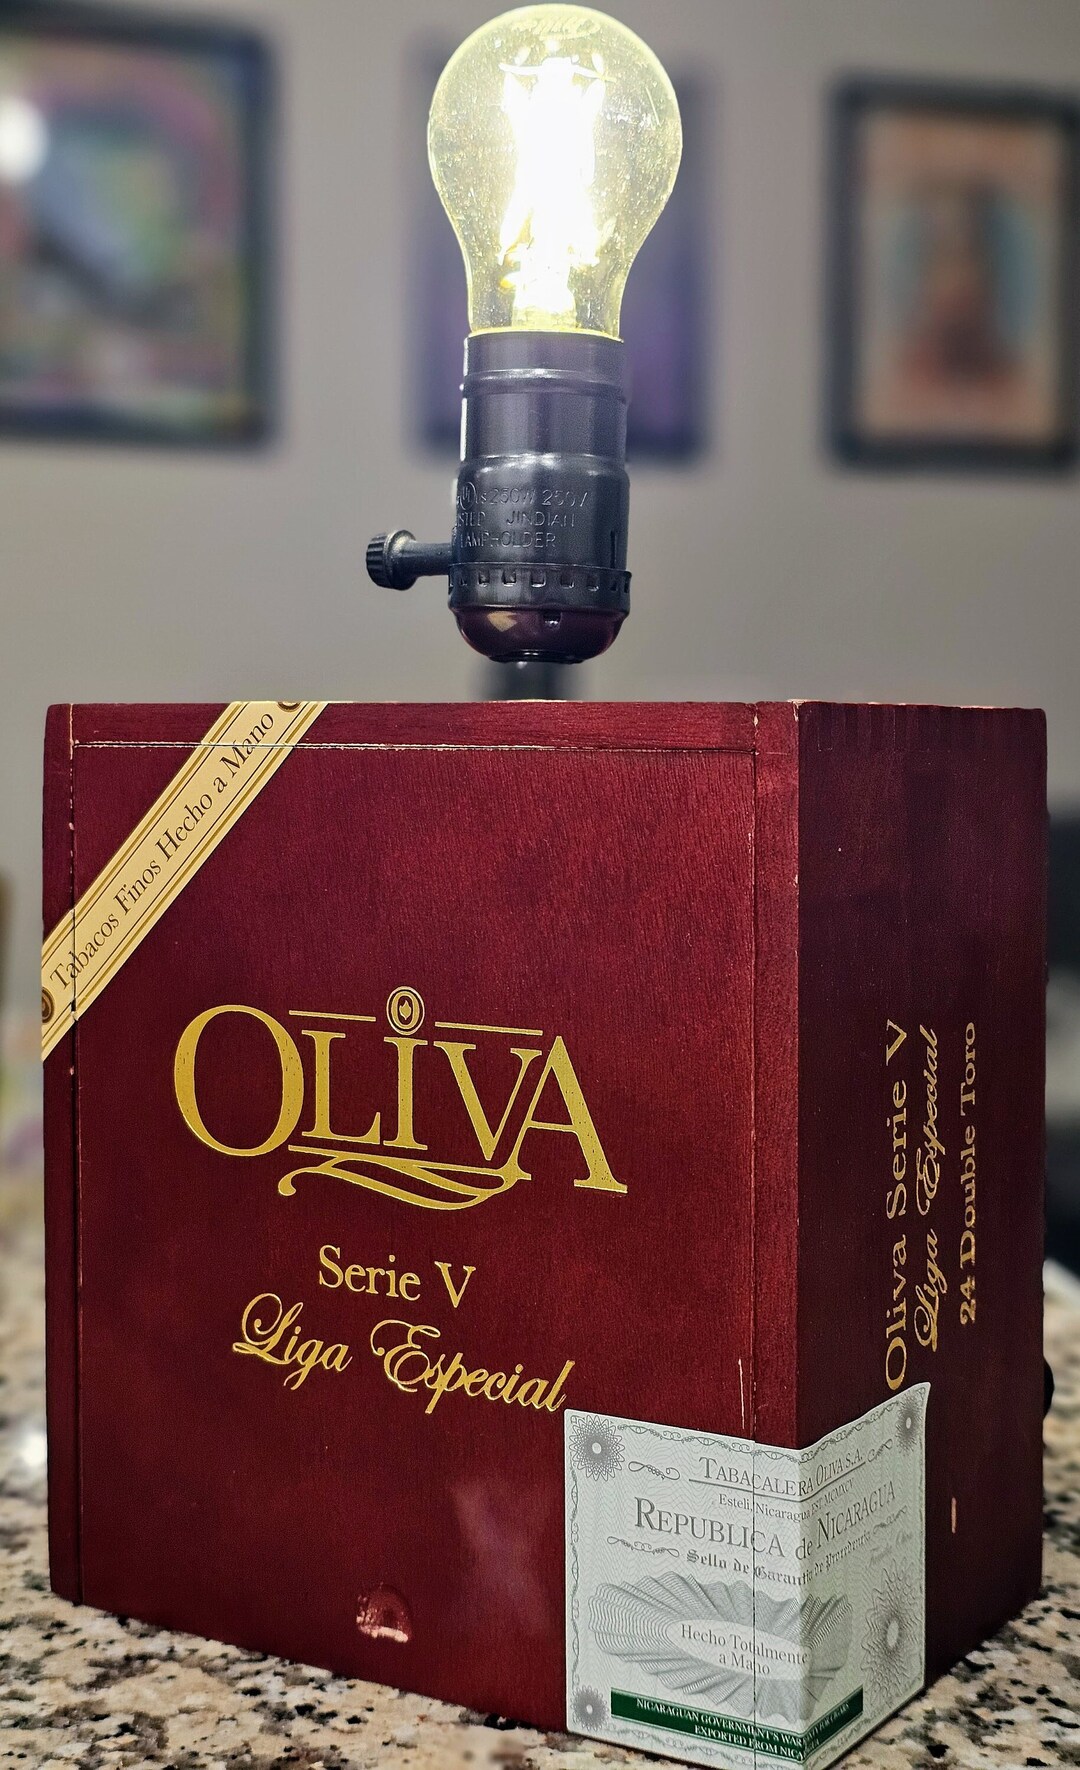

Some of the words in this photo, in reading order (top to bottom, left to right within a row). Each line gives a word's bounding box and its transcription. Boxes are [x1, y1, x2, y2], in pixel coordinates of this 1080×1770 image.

[220, 714, 274, 778] Mano
[213, 777, 228, 793] a
[154, 795, 213, 862] Hecho
[113, 859, 162, 914] Finos
[50, 914, 119, 990] Tabacos
[886, 1019, 907, 1066] V
[960, 1022, 976, 1116] Toro
[174, 1003, 628, 1194] OLIVA
[916, 1024, 945, 1216] Especial
[886, 1080, 907, 1219] Serie
[960, 1125, 976, 1269] Double
[319, 1245, 420, 1301] Serie
[434, 1261, 476, 1308] V
[914, 1228, 948, 1352] Liga
[960, 1274, 976, 1325] 24
[886, 1234, 907, 1391] Oliva
[232, 1293, 352, 1390] Liga
[371, 1320, 575, 1413] Especial
[698, 1456, 813, 1497] TABACALERA
[815, 1458, 843, 1486] OLIVA
[845, 1449, 863, 1468] S.A.
[634, 1496, 785, 1558] REPUBLICA
[795, 1537, 812, 1560] de
[816, 1480, 896, 1549] NICARAGUA
[755, 1502, 812, 1523] Nicaragua
[686, 1549, 728, 1570] Sello
[733, 1557, 750, 1575] de
[680, 1623, 726, 1646] Hecho
[730, 1634, 809, 1665] Totalmente
[719, 1654, 727, 1664] a
[731, 1651, 770, 1675] Mano
[636, 1698, 700, 1722] NICARAGUAN
[695, 1725, 747, 1746] EXPORTED
[749, 1740, 778, 1753] FROM
